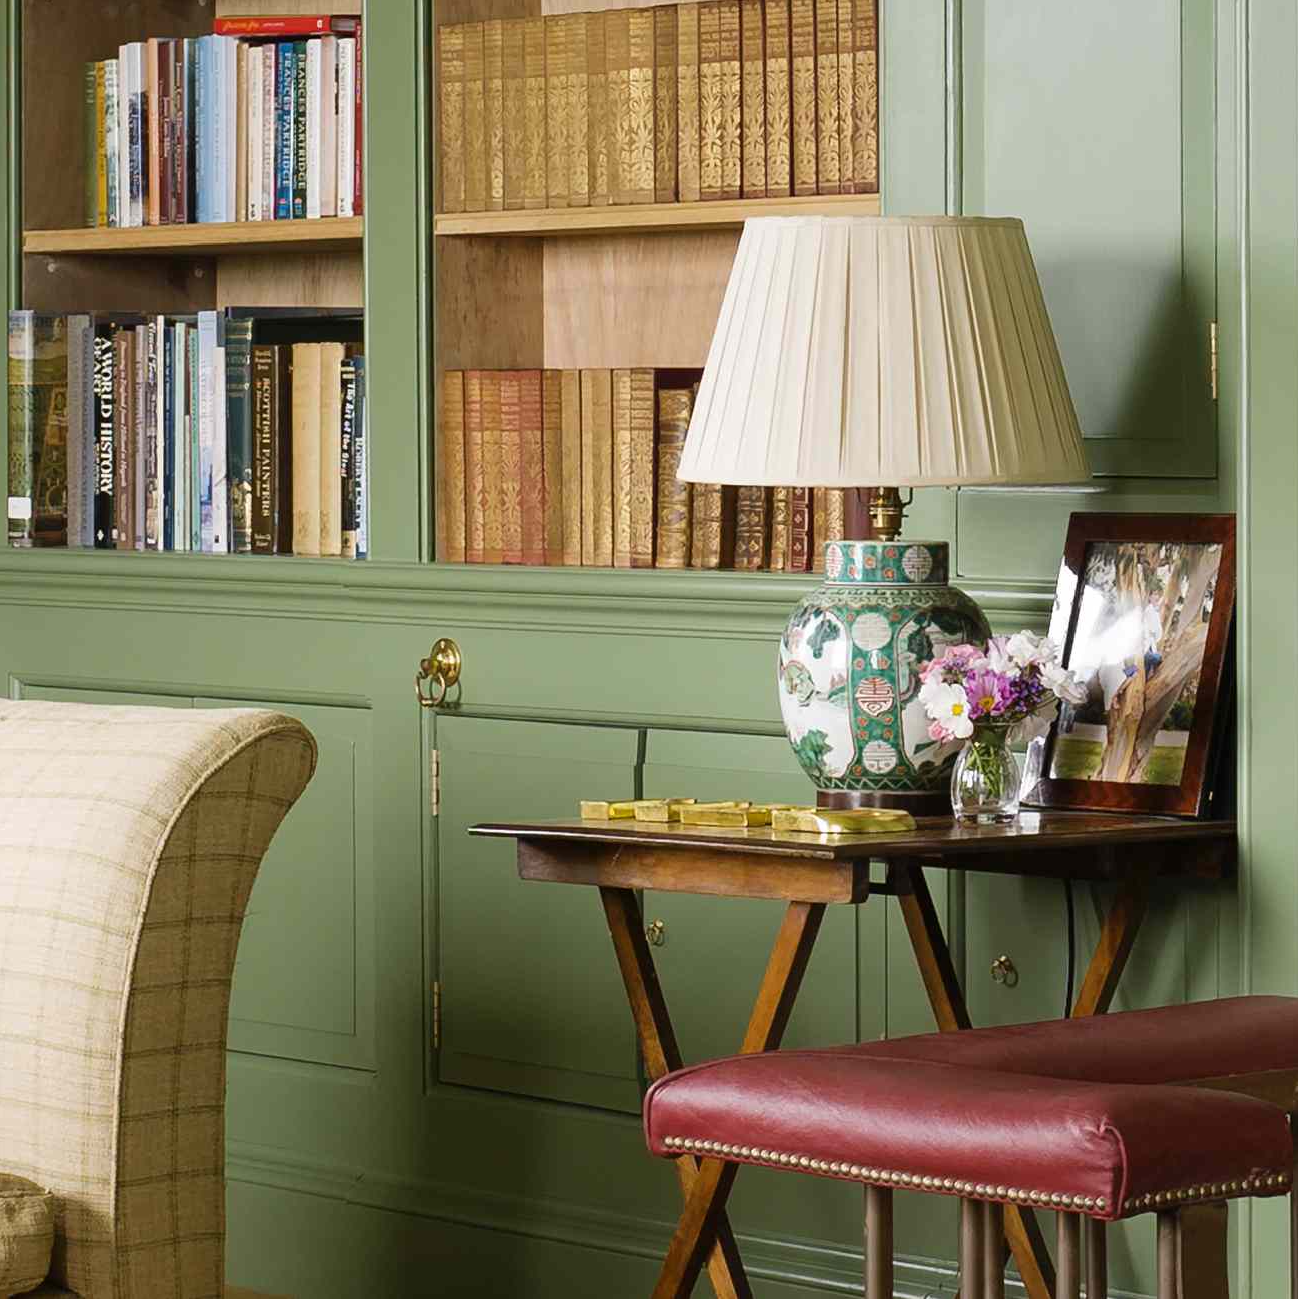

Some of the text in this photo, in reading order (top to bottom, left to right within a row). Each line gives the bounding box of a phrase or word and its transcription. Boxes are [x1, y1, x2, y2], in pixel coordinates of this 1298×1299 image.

[282, 52, 292, 188] FRANCES PARTRIDGE
[297, 53, 306, 190] FRANCES PARTRIDGE
[94, 336, 102, 398] OF ART
[346, 383, 356, 402] The
[100, 337, 114, 496] A WORLD HISTORY
[343, 433, 352, 449] the
[344, 404, 354, 419] Art
[261, 378, 271, 517] SCOTTISH PAINTERS
[341, 451, 351, 477] Steal
